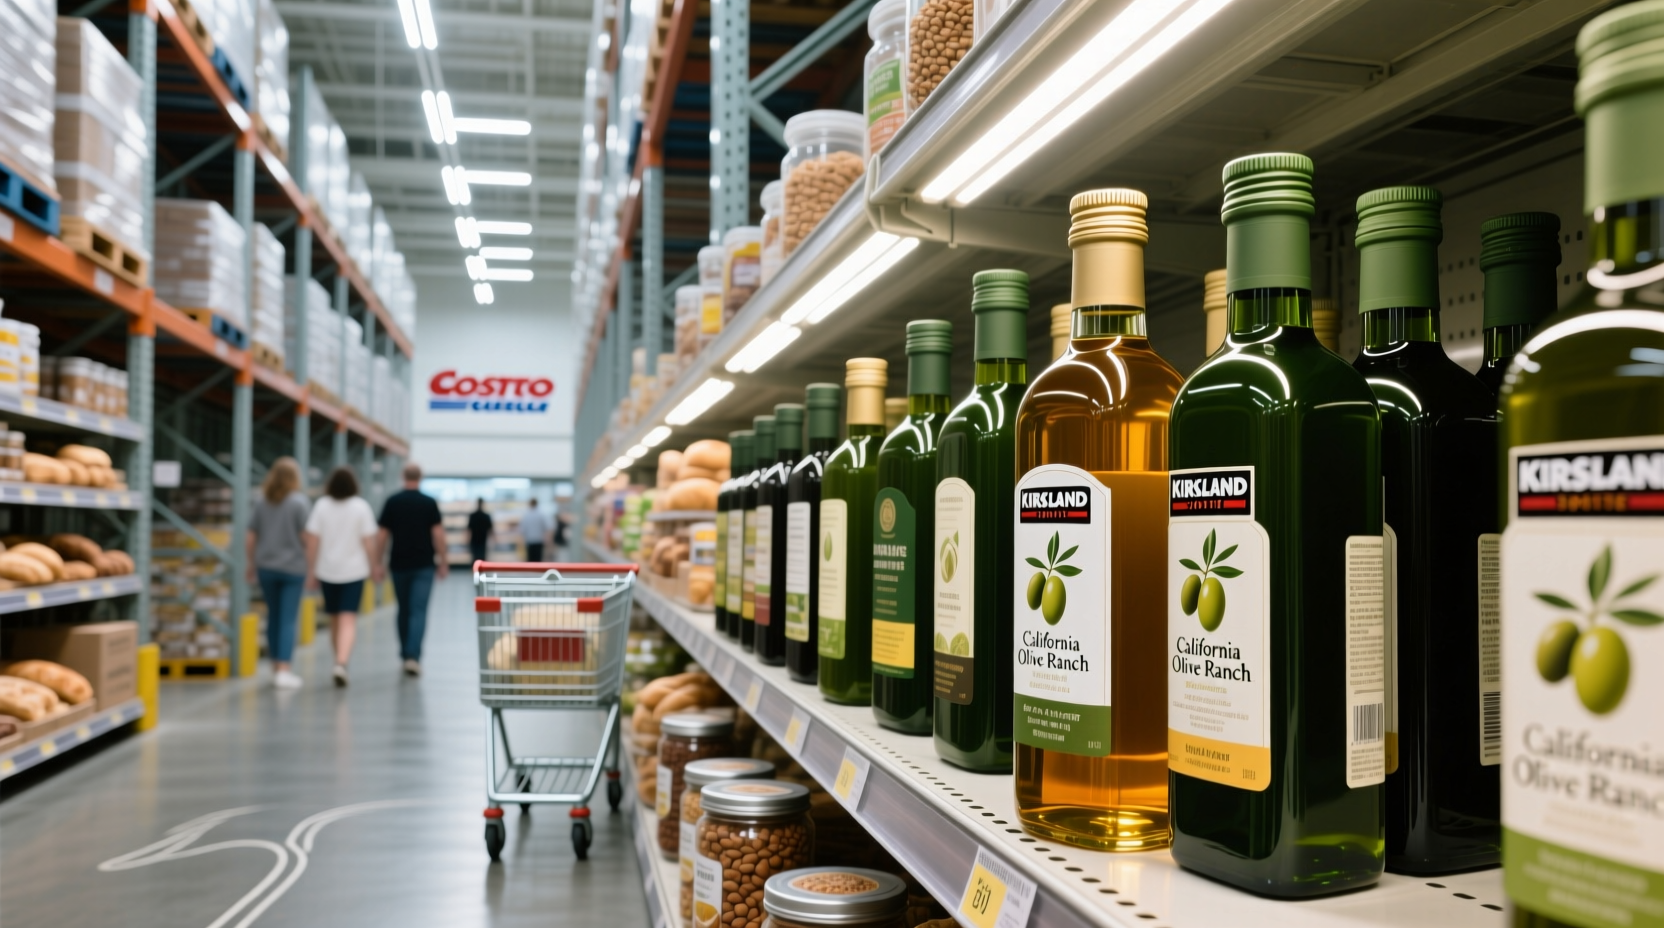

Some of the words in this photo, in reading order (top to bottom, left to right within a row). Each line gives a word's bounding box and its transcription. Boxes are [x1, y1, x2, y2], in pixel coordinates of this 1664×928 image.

[1518, 452, 1664, 493] KIRSLAN
[1021, 490, 1088, 509] KIRSLAND
[1172, 476, 1248, 499] KIRSLAND
[1022, 630, 1080, 652] California
[1176, 636, 1241, 660] California
[1018, 648, 1044, 667] Olive
[1047, 652, 1089, 672] Ranch
[1172, 654, 1201, 676] Olive
[1204, 659, 1252, 682] Ranch
[1512, 753, 1580, 800] Olive
[1588, 771, 1664, 819] Ranc
